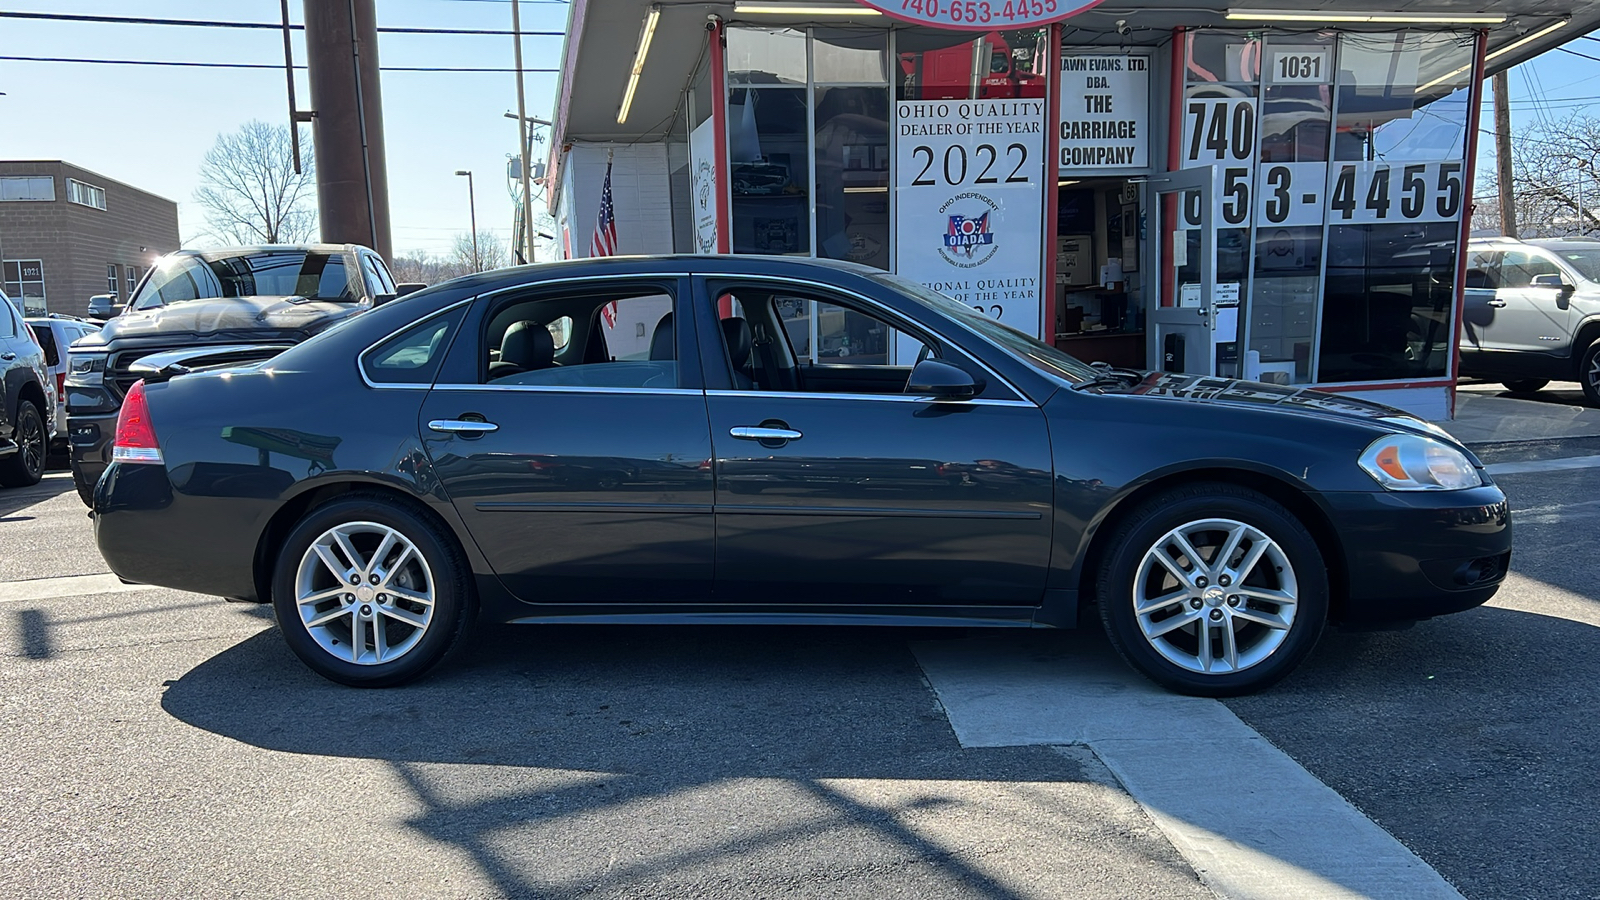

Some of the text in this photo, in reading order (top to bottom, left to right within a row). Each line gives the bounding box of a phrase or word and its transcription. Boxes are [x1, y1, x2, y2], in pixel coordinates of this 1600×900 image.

[1061, 58, 1147, 71] AWN EVANS. LTD.
[1279, 55, 1321, 79] 1031
[1086, 76, 1110, 89] DBA.
[898, 102, 1043, 120] OHIO QUALITY
[1084, 95, 1112, 113] THE
[901, 121, 1041, 136] DEALER OF THE YEAR
[1060, 121, 1136, 140] CARRIAGE
[1188, 101, 1255, 161] 740
[911, 143, 1029, 186] 2022
[1061, 147, 1135, 166] COMPANY
[938, 192, 1000, 214] OHIO INDEPENDENT
[949, 234, 985, 246] OIADA
[23, 268, 40, 276] 1921
[922, 278, 1036, 291] IONAL QUALITY
[954, 290, 1034, 302] OF THE YEAR
